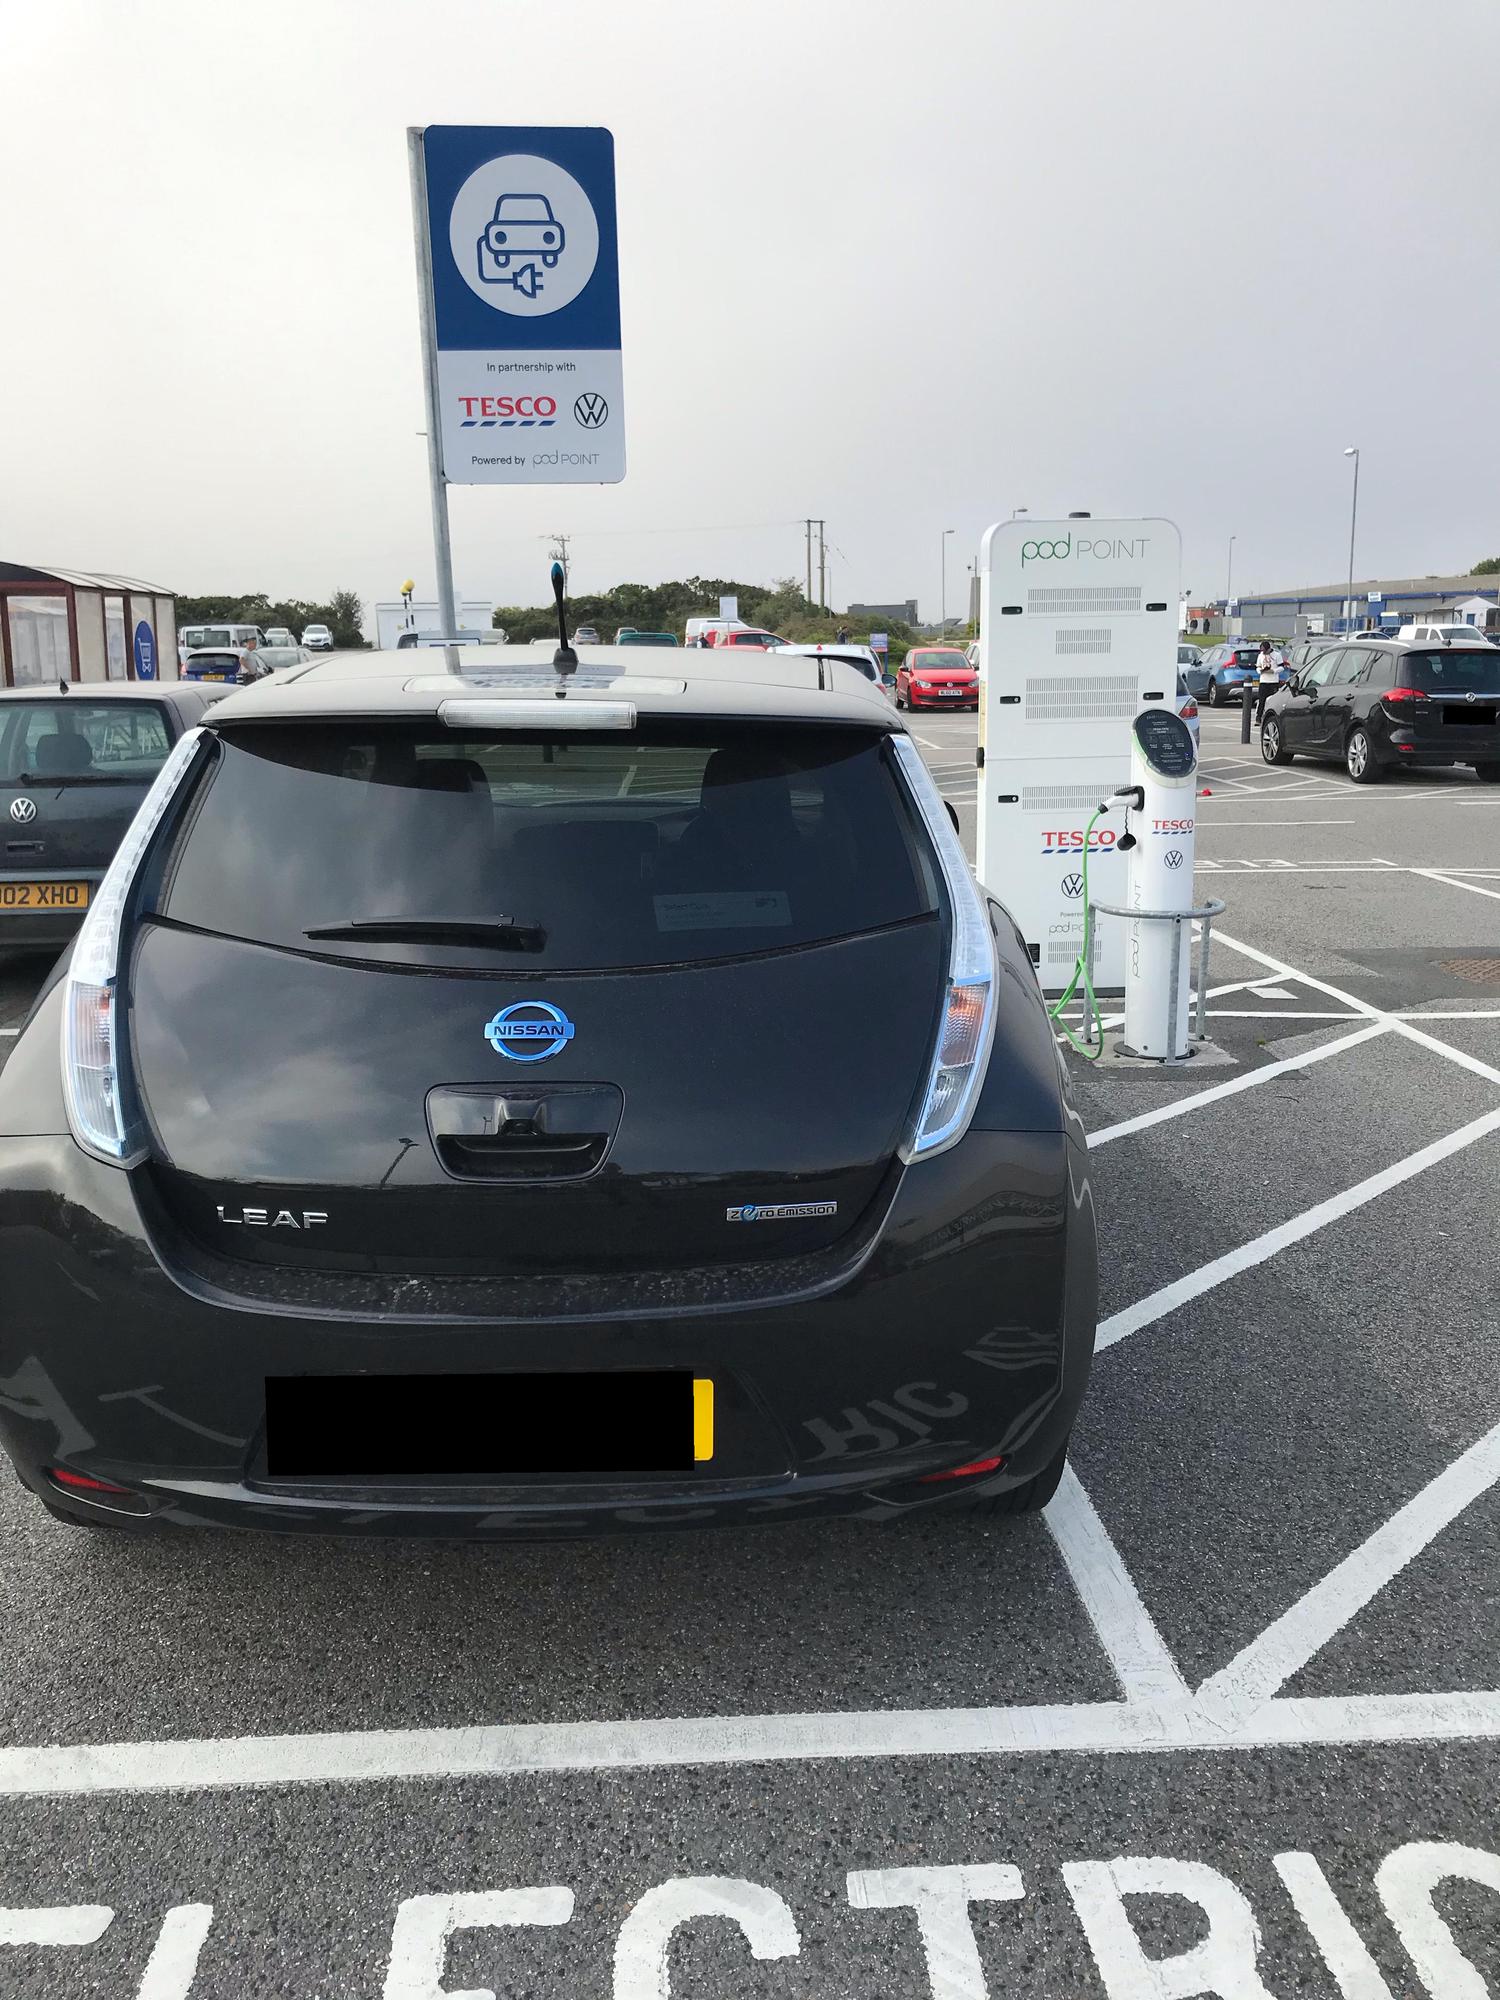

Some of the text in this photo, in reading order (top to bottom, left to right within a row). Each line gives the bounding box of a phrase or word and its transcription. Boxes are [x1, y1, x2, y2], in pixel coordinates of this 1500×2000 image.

[487, 362, 576, 374] In partnership with
[458, 396, 557, 418] TESCO
[471, 450, 600, 468] Powered by pod POINT
[1020, 531, 1151, 569] pod POINT
[1152, 819, 1194, 831] TESCO
[1041, 830, 1117, 847] TESCO
[0, 885, 80, 906] 02 XHO
[1071, 923, 1104, 933] POT
[493, 1025, 565, 1036] NISSAN
[216, 1205, 329, 1229] LEAF
